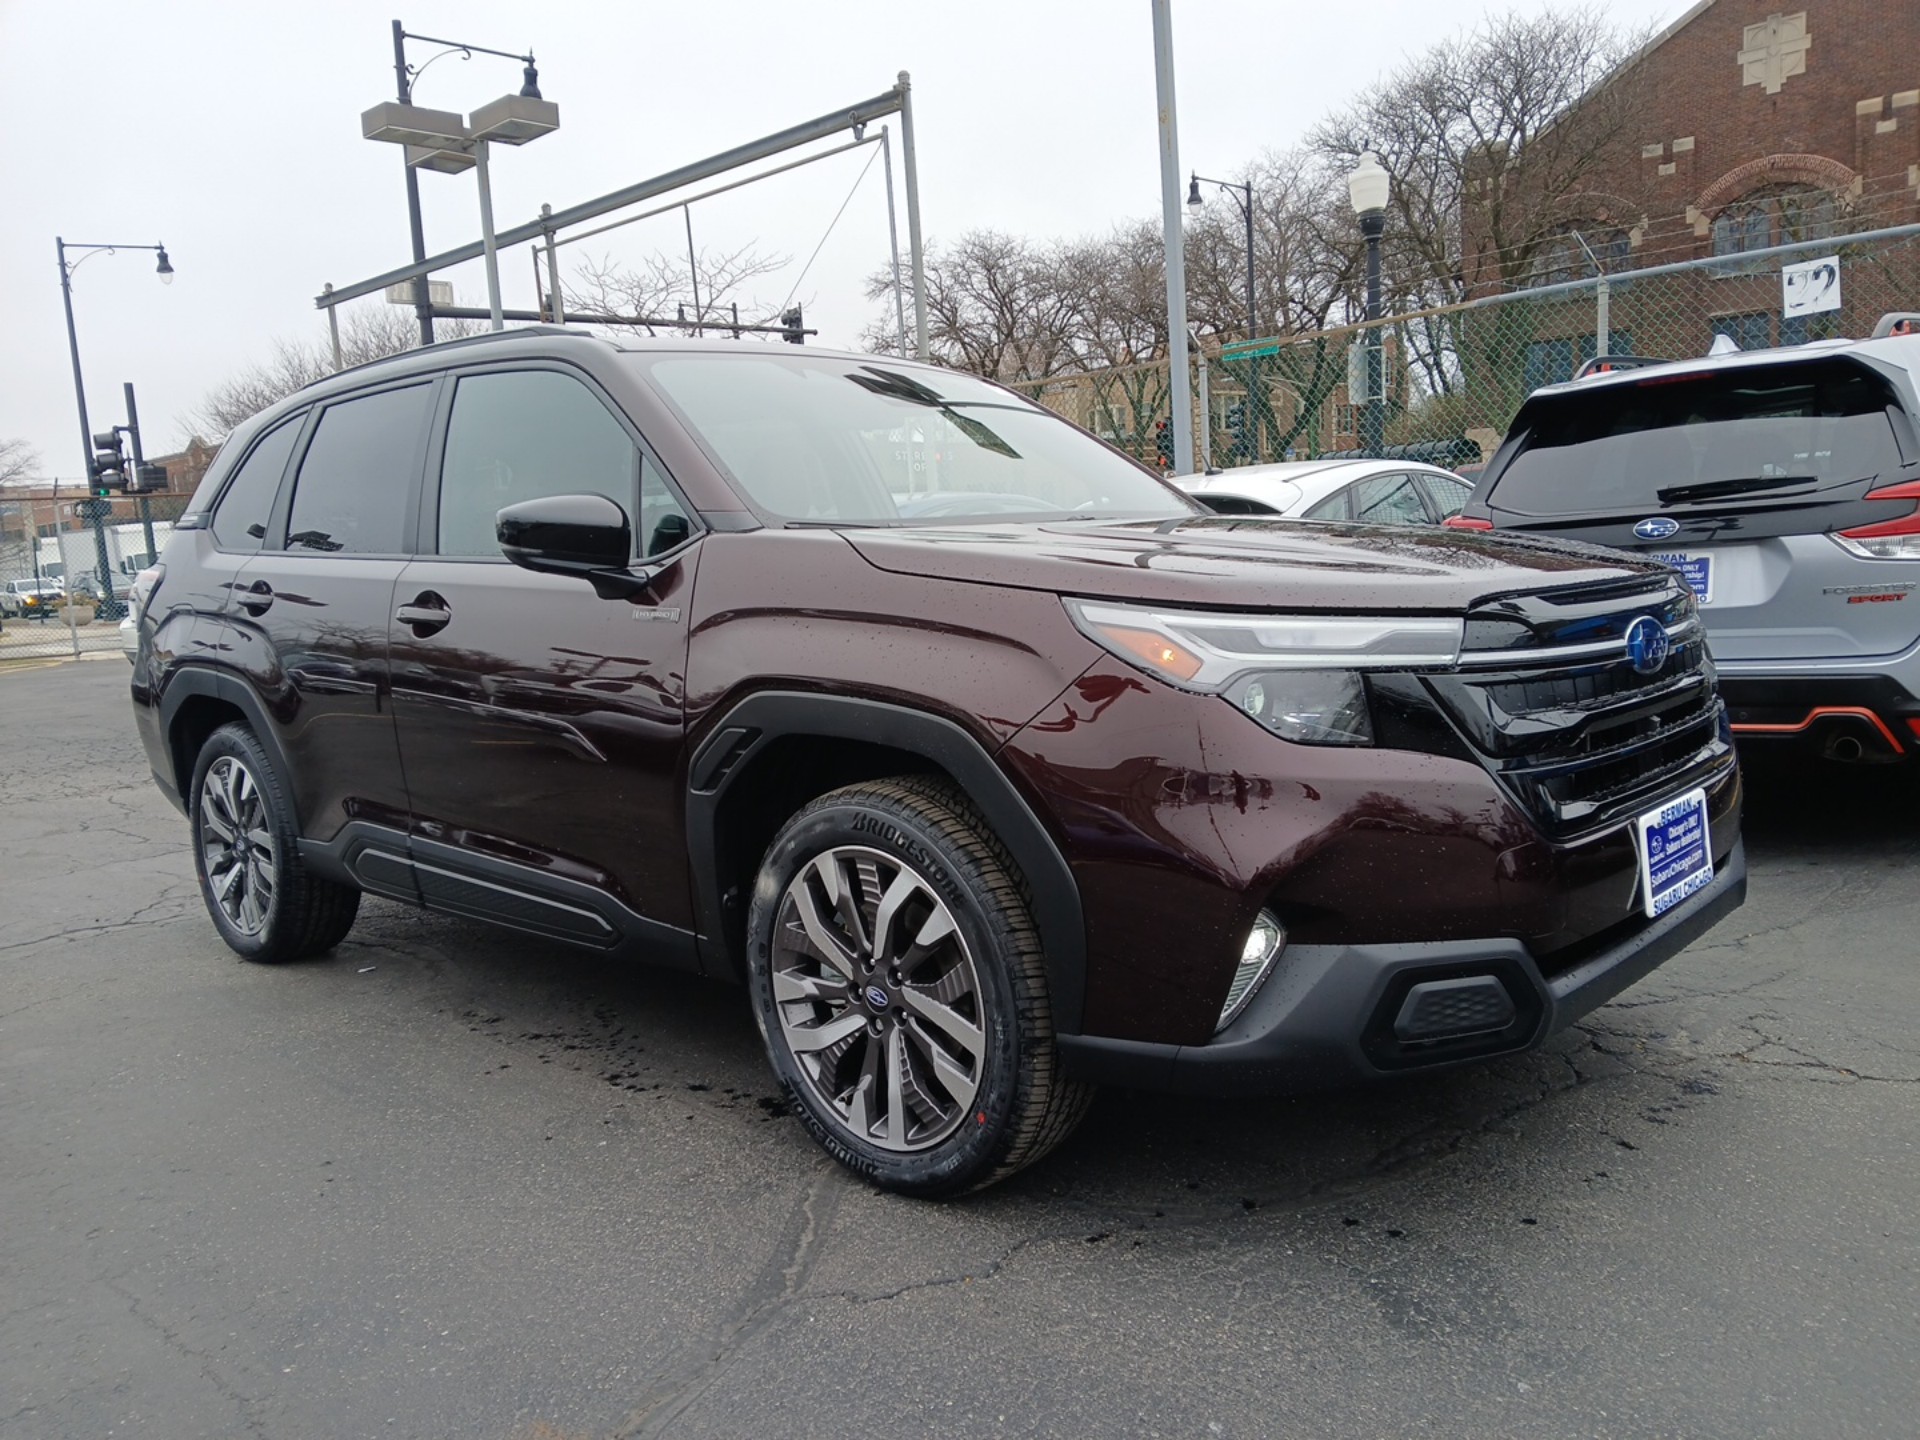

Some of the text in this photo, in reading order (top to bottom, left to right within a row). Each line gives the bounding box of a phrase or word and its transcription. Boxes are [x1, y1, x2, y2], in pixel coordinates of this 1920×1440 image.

[1822, 581, 1917, 596] FORESTER
[1847, 593, 1908, 604] SPORT
[851, 811, 967, 910] BRIDGESTONE
[1653, 883, 1682, 915] SUBARU
